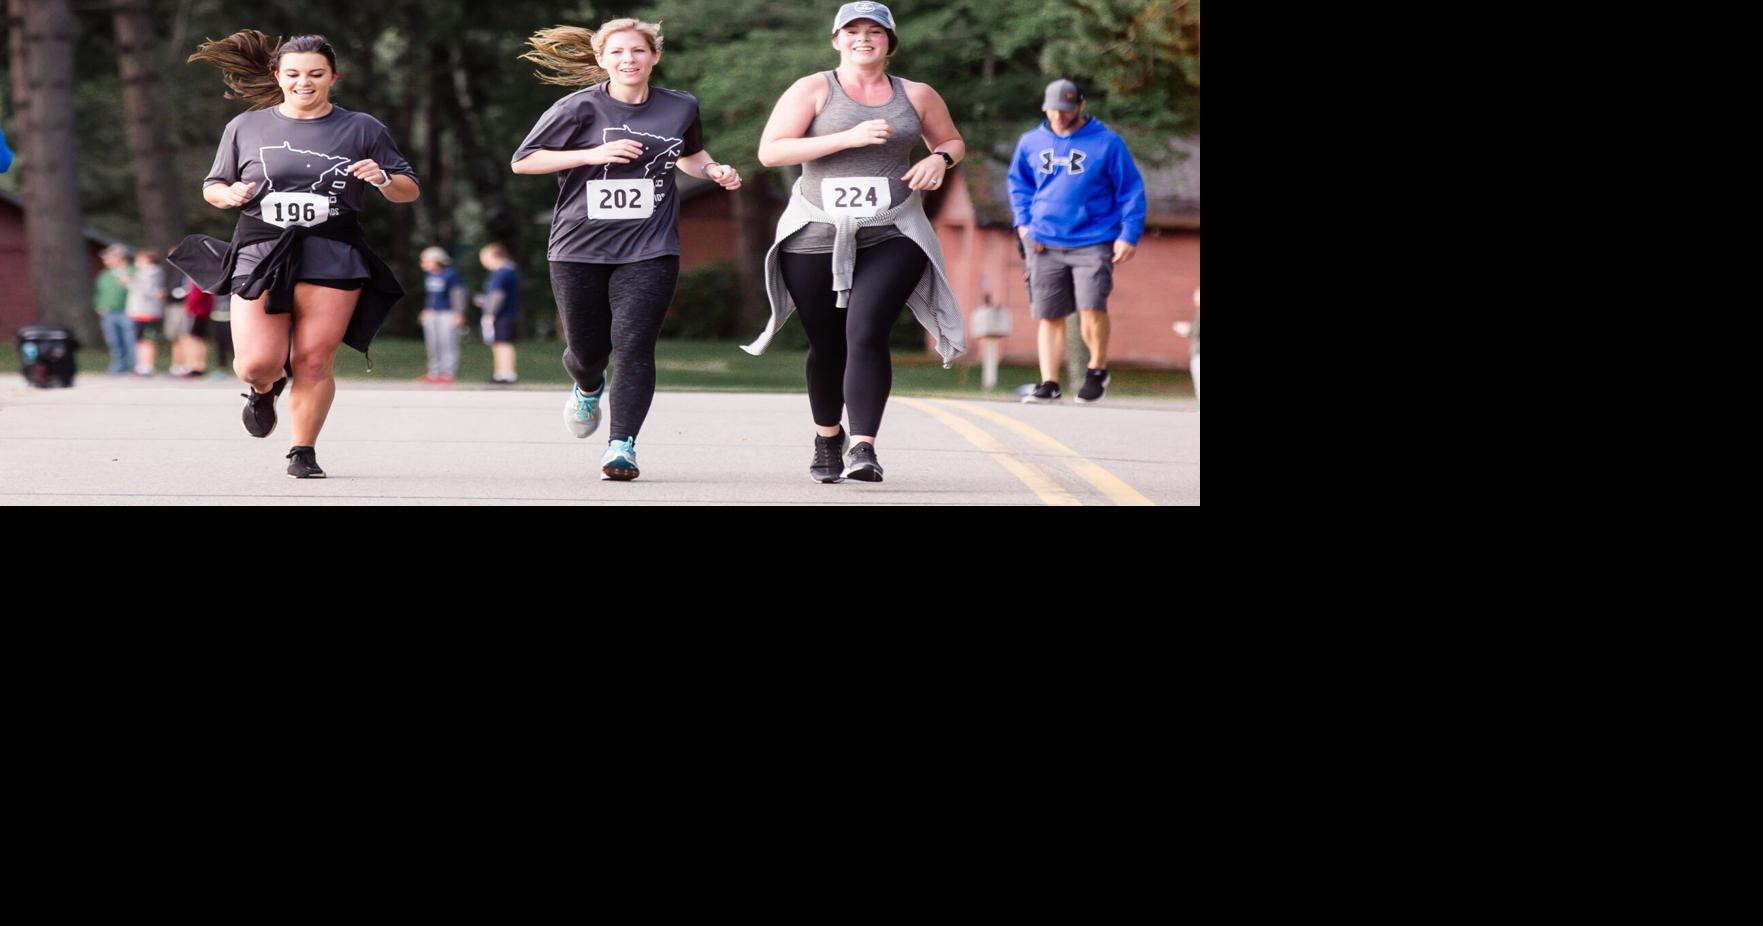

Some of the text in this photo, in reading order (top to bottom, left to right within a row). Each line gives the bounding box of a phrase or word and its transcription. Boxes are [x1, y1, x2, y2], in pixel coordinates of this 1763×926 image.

[599, 188, 642, 209] 202
[834, 186, 878, 208] 224
[274, 202, 316, 222] 196
